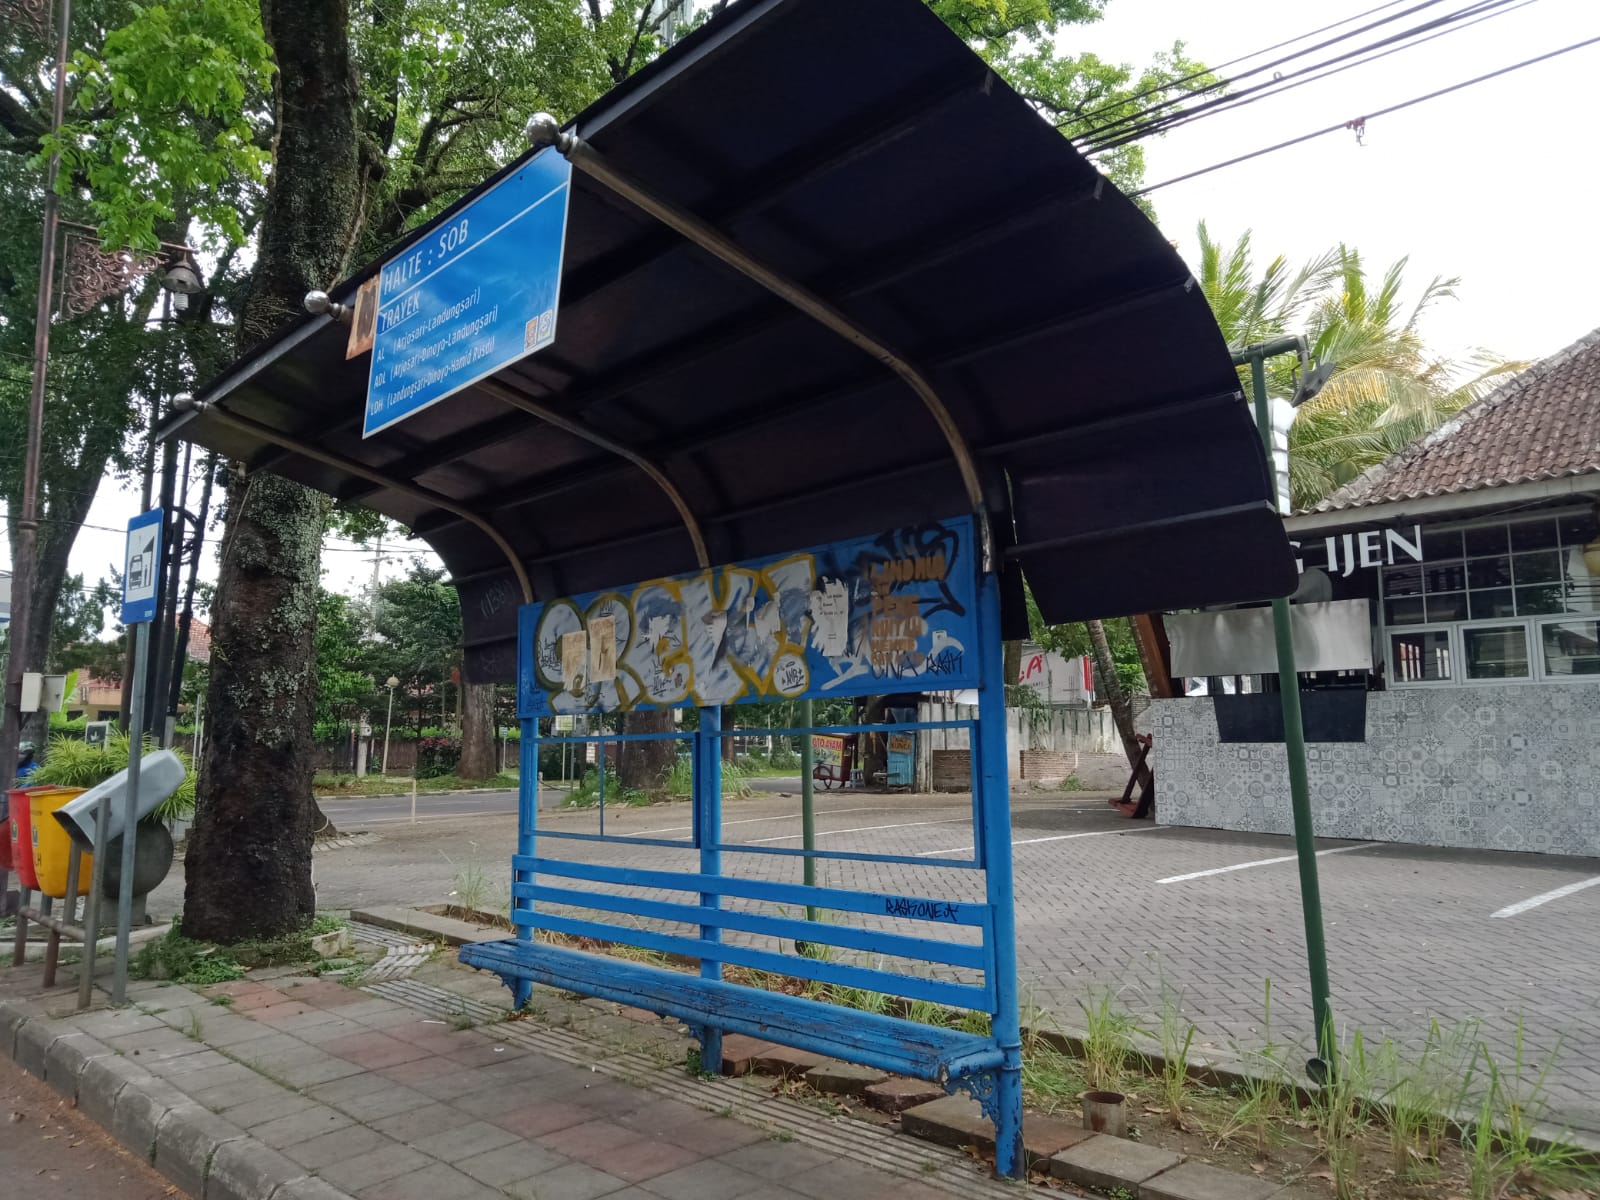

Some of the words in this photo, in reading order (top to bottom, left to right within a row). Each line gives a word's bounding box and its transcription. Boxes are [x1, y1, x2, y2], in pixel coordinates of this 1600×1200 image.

[384, 250, 423, 296] HALTE
[437, 218, 468, 259] SOB
[381, 290, 421, 331] TRAYEK
[1325, 524, 1423, 578] IJEN
